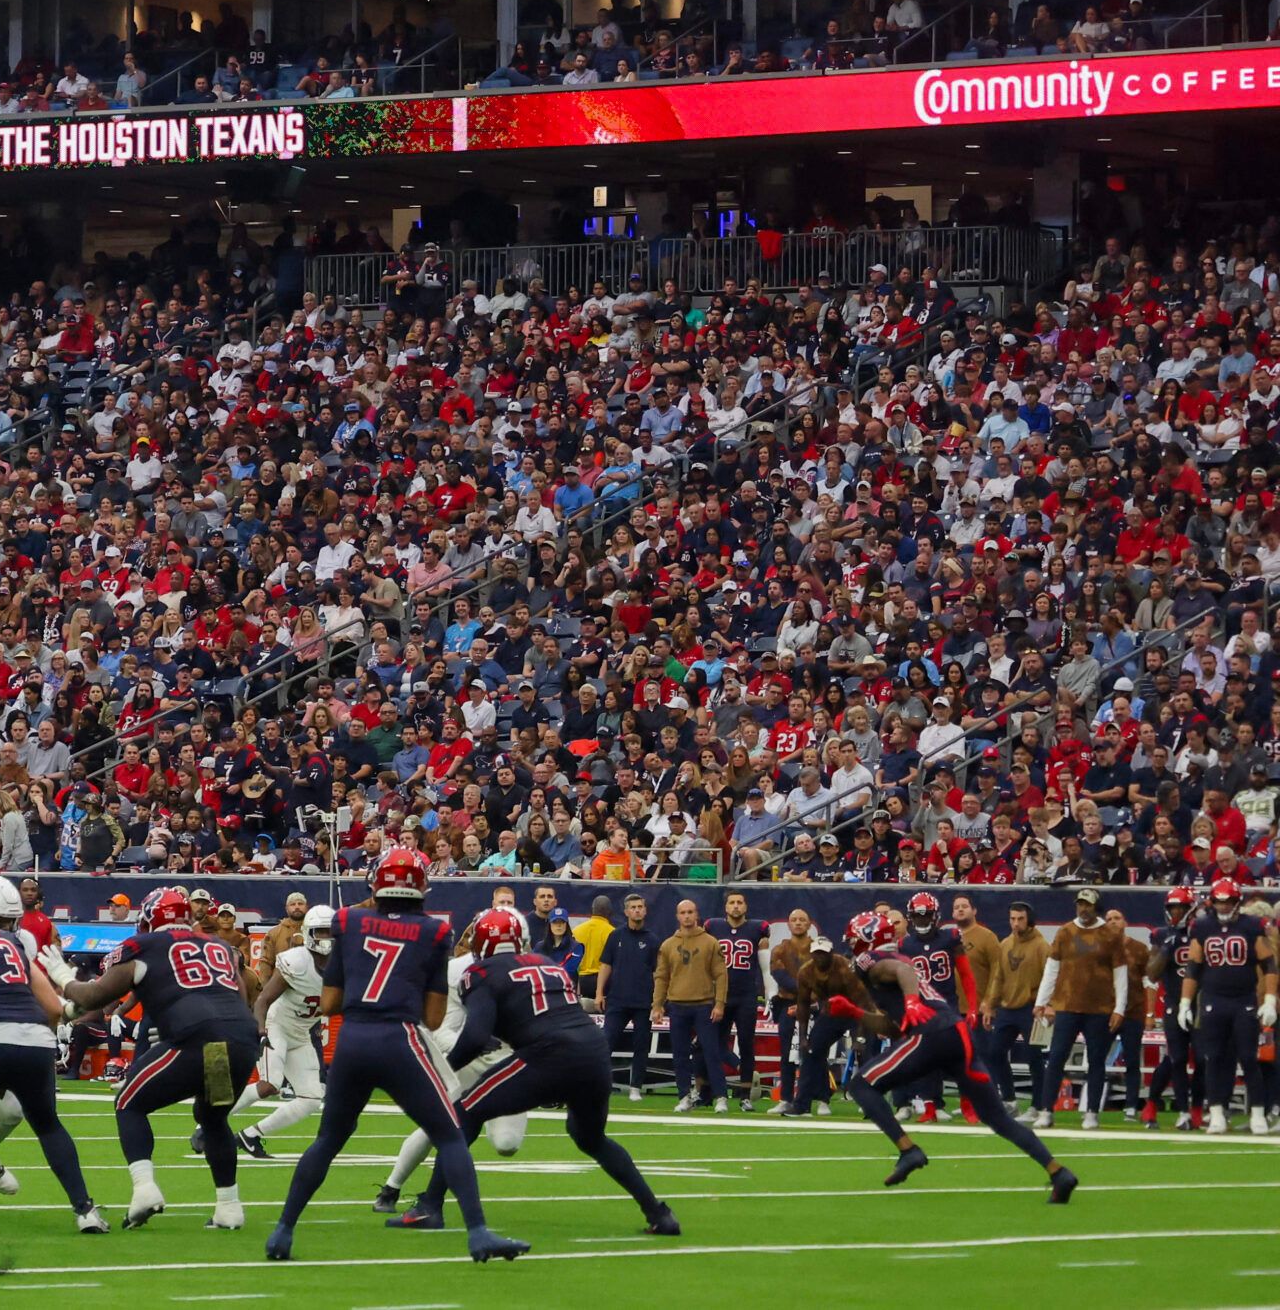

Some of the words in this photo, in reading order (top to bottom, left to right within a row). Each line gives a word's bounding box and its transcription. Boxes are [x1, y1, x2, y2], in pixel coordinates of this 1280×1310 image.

[249, 52, 265, 65] 99
[392, 49, 401, 63] 7
[914, 60, 1115, 125] Community
[1123, 66, 1280, 96] COFFEE
[58, 118, 188, 164] HOUSTON
[195, 112, 304, 157] TEXANS
[889, 327, 898, 341] 4
[441, 494, 452, 509] 7
[101, 579, 118, 593] 59
[256, 652, 270, 665] 7
[777, 732, 797, 752] 23
[1172, 731, 1182, 750] 7
[223, 763, 234, 780] 7
[360, 917, 420, 941] STROUD
[1205, 936, 1248, 967] 60
[168, 941, 240, 991] 69
[362, 936, 405, 1003] 7
[509, 965, 578, 1016] 77
